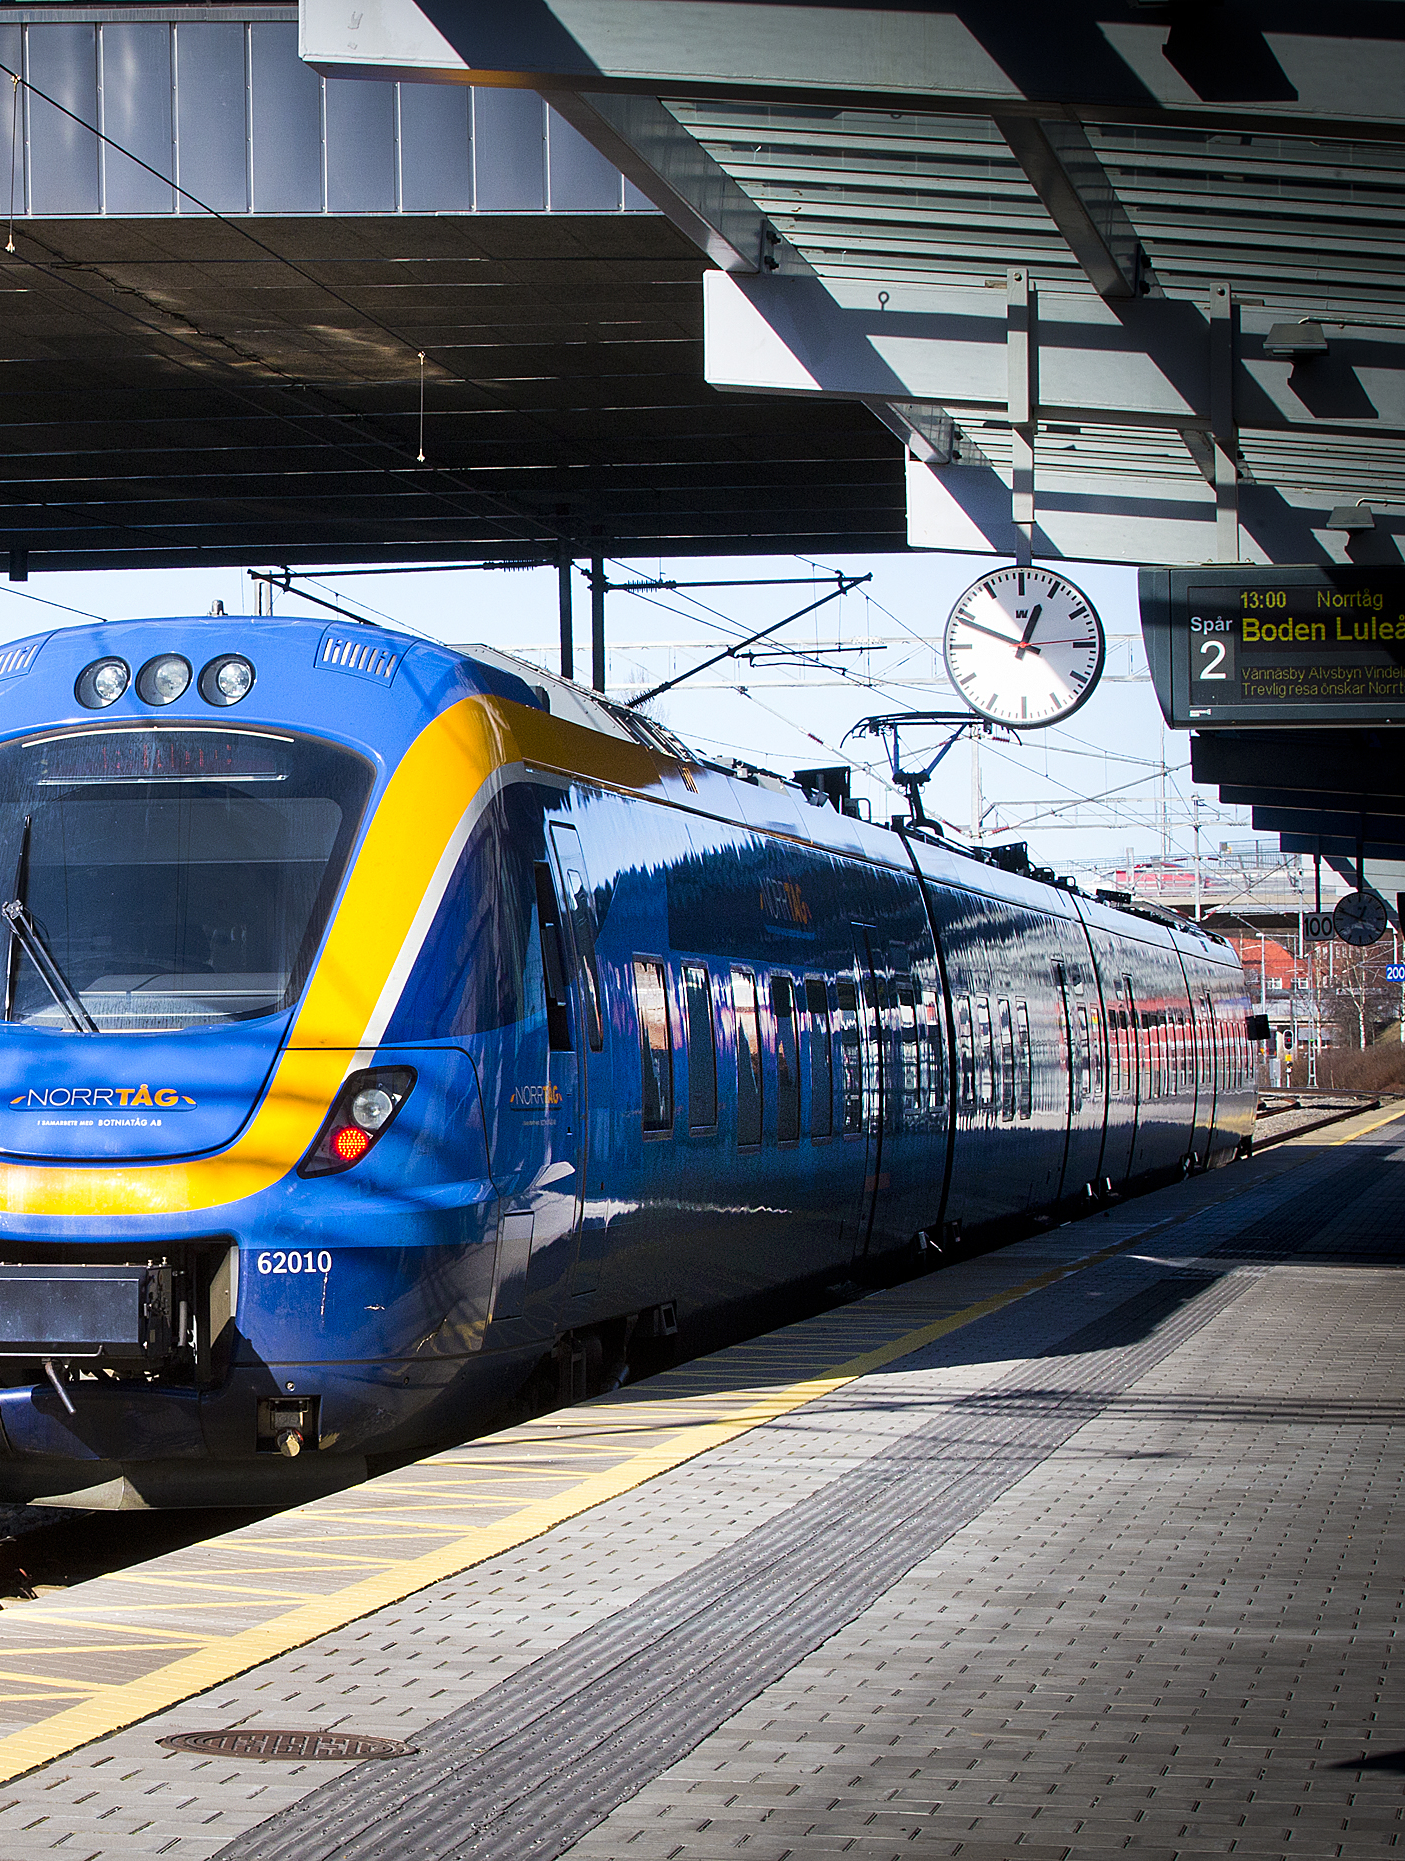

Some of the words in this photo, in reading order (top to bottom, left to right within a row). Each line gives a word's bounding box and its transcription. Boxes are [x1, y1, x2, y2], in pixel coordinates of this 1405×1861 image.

[1240, 591, 1287, 609] 13:00
[1317, 589, 1383, 611] Norrtåg
[1190, 616, 1233, 635] Spår
[1242, 617, 1326, 642] Boden
[1336, 614, 1405, 641] Luleå
[1199, 640, 1227, 679] 2
[1364, 666, 1405, 678] Vindel
[1241, 682, 1286, 698] Trevlig
[1289, 684, 1318, 695] resa
[1320, 683, 1365, 695] önskar
[1368, 681, 1405, 694] Norrt
[1304, 917, 1332, 937] 100
[1387, 967, 1405, 980] 200
[27, 1084, 179, 1106] NORRTÅG
[515, 1081, 559, 1105] NORRTÅG
[98, 1118, 148, 1127] BOTNIATÅG
[150, 1119, 162, 1127] AB
[257, 1250, 332, 1274] 62010
